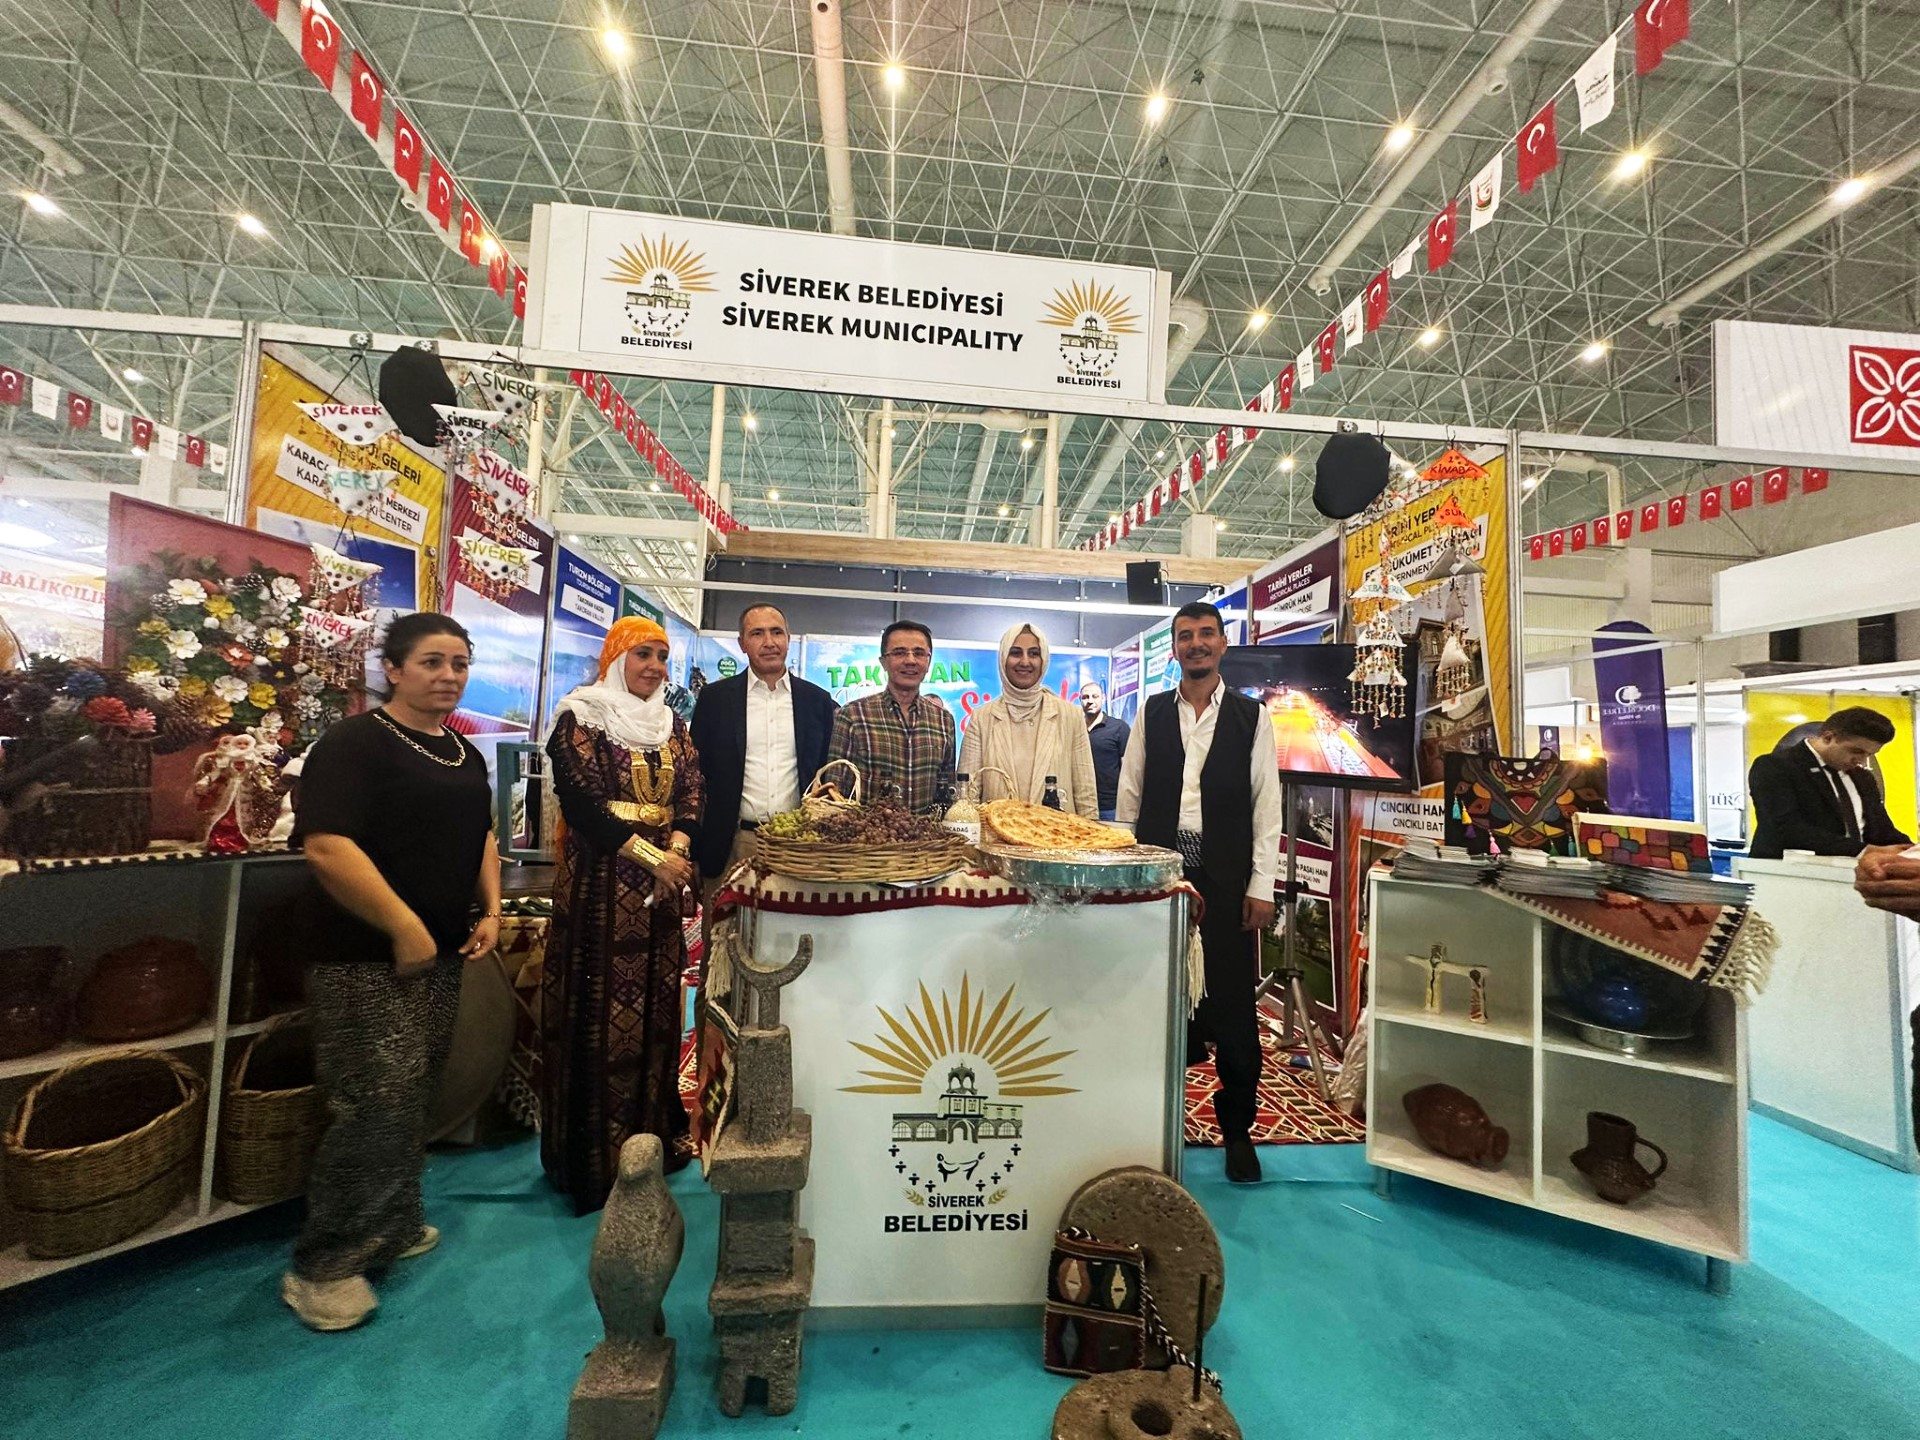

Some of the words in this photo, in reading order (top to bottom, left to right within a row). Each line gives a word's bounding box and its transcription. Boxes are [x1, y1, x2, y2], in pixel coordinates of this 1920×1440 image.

[739, 268, 850, 302] SİVEREK
[858, 284, 1003, 317] BELEDİYESİ
[643, 329, 671, 338] SİVEREK
[722, 302, 834, 335] SİVEREK
[841, 317, 1023, 352] MUNICIPALITY
[621, 336, 692, 350] BELEDİYESİ
[1057, 375, 1121, 389] BELEDİYESİ
[1076, 368, 1102, 377] SİVEREK
[386, 497, 420, 522] MERKEZİ
[380, 510, 412, 532] CENTER
[1390, 545, 1433, 572] ÜKÜMET
[1287, 563, 1313, 583] YERLER
[827, 661, 970, 687] TAKAN
[928, 1193, 985, 1207] SİVEREK
[884, 1209, 1028, 1232] BELEDİYESİ
